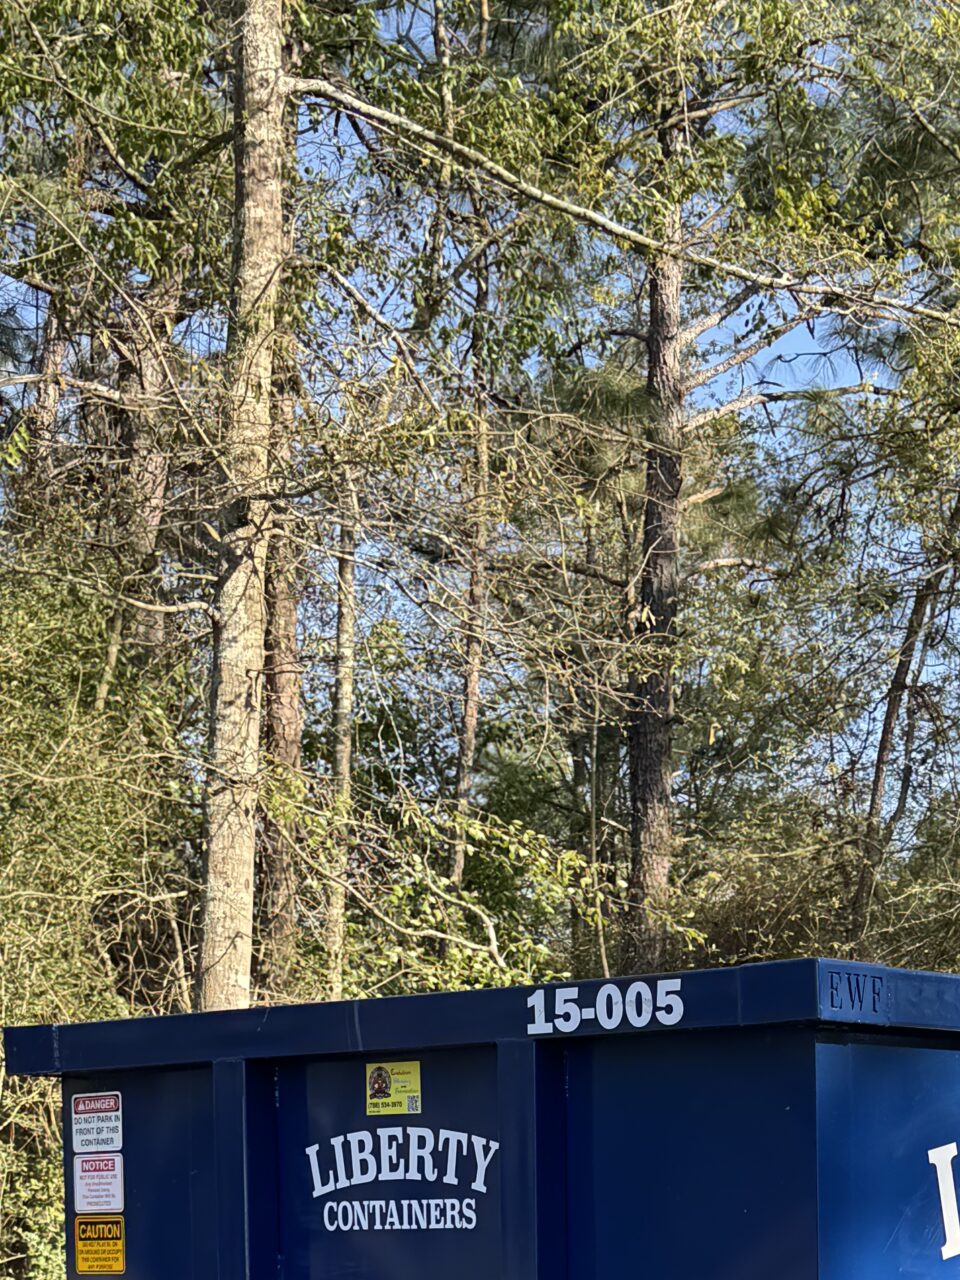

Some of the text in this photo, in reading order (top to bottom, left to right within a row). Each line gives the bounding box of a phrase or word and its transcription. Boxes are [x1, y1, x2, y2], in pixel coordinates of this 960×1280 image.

[827, 970, 884, 1014] EWF
[526, 978, 685, 1035] 15-005
[85, 1098, 116, 1110] DANGER
[74, 1114, 120, 1125] DO NOT PARK IN
[75, 1125, 119, 1136] FRONT OF THIS
[81, 1137, 114, 1147] CONTAINER
[82, 1160, 115, 1171] NOTICE
[305, 1126, 500, 1199] LIBERTY
[323, 1197, 478, 1232] CONTAINERS
[80, 1224, 120, 1238] CAUTION
